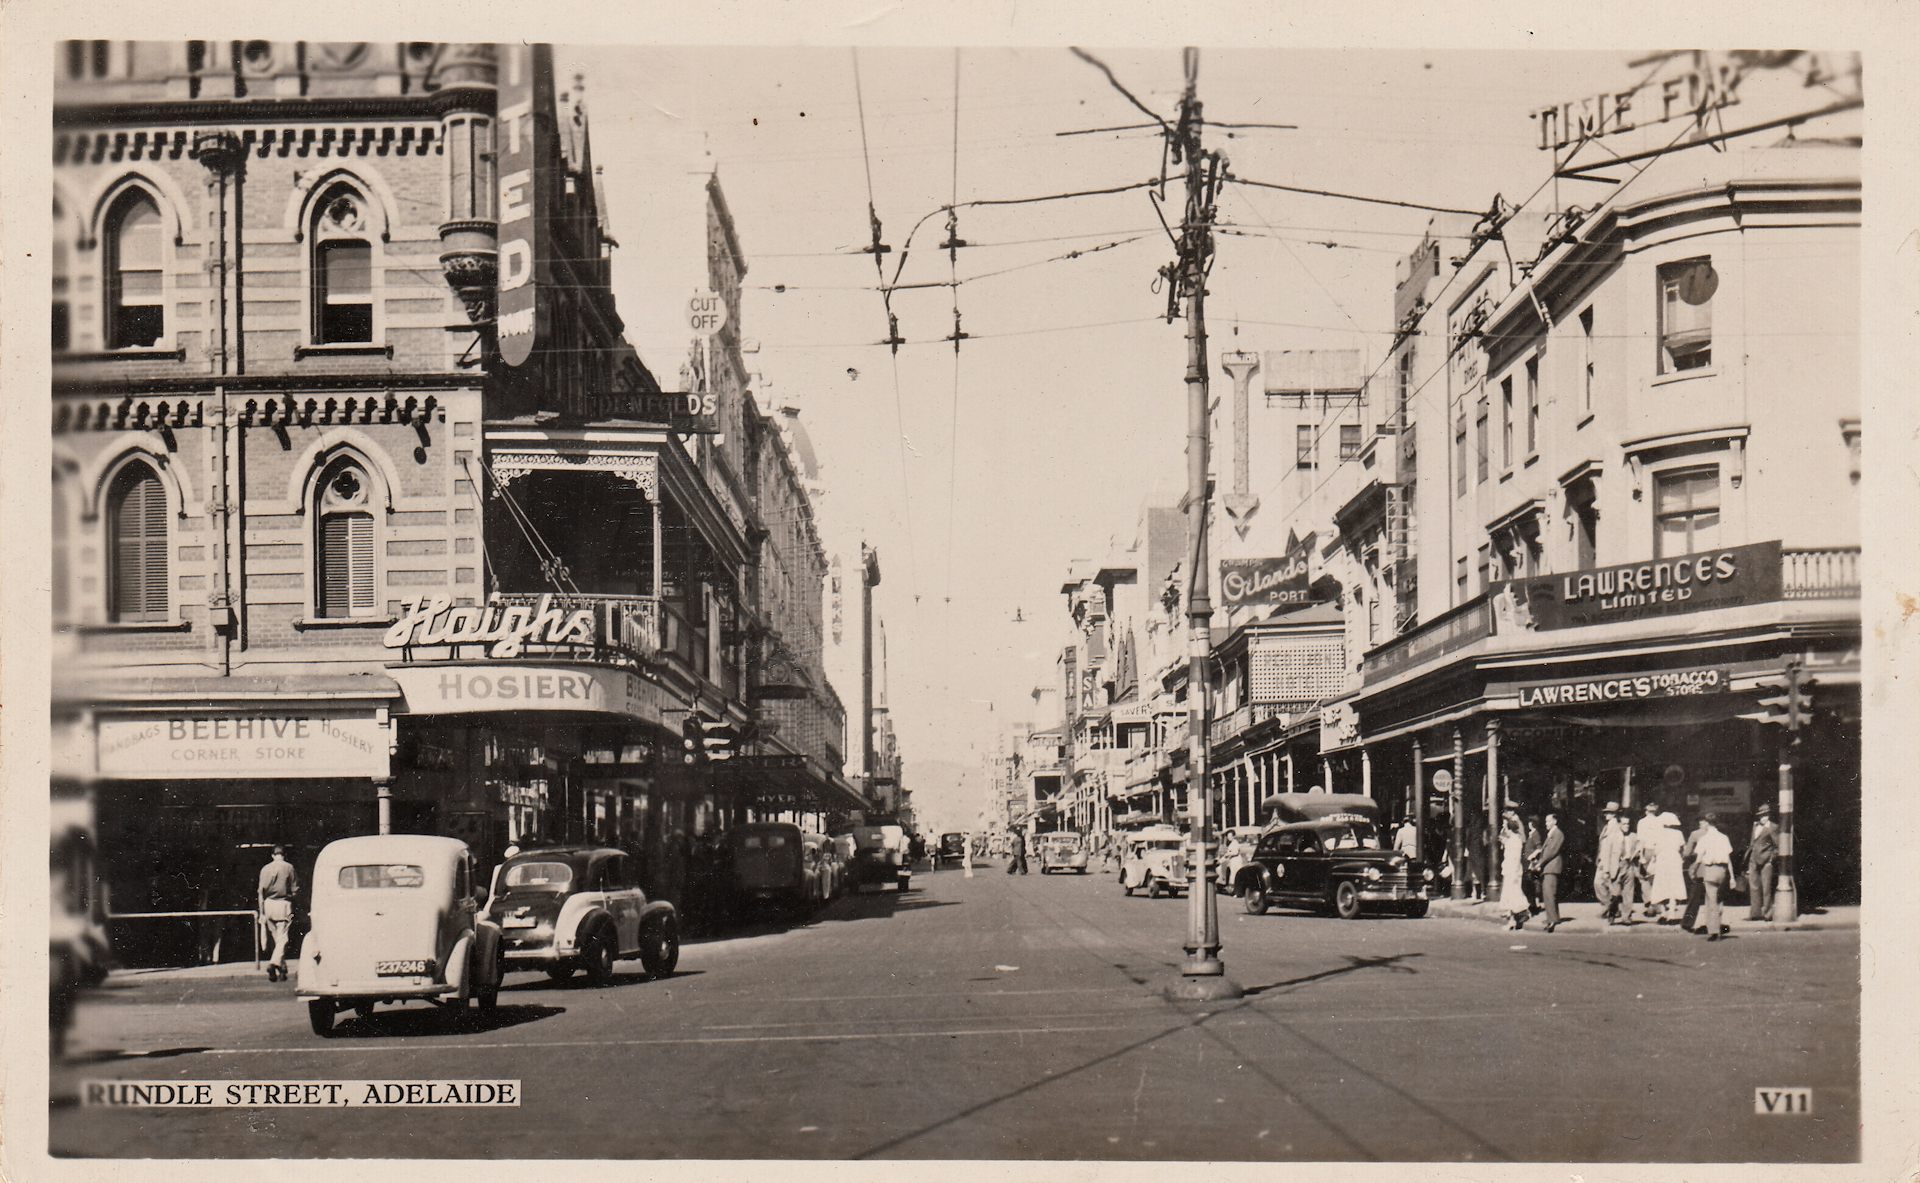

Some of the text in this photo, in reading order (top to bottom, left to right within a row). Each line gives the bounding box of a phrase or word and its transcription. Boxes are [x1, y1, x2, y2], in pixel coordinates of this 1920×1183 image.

[690, 298, 718, 312] CUT
[691, 315, 718, 329] OFF
[1223, 557, 1308, 601] Orlando
[1564, 552, 1737, 600] LAWRENCES
[1269, 590, 1307, 601] PORT
[1602, 587, 1692, 610] LIMITED
[438, 671, 595, 700] HOSIERY
[1651, 670, 1718, 690] TOBACCO
[102, 717, 374, 755] ANDBAGS BEEHIVE HOSIERY
[171, 747, 306, 761] CORNER STORE
